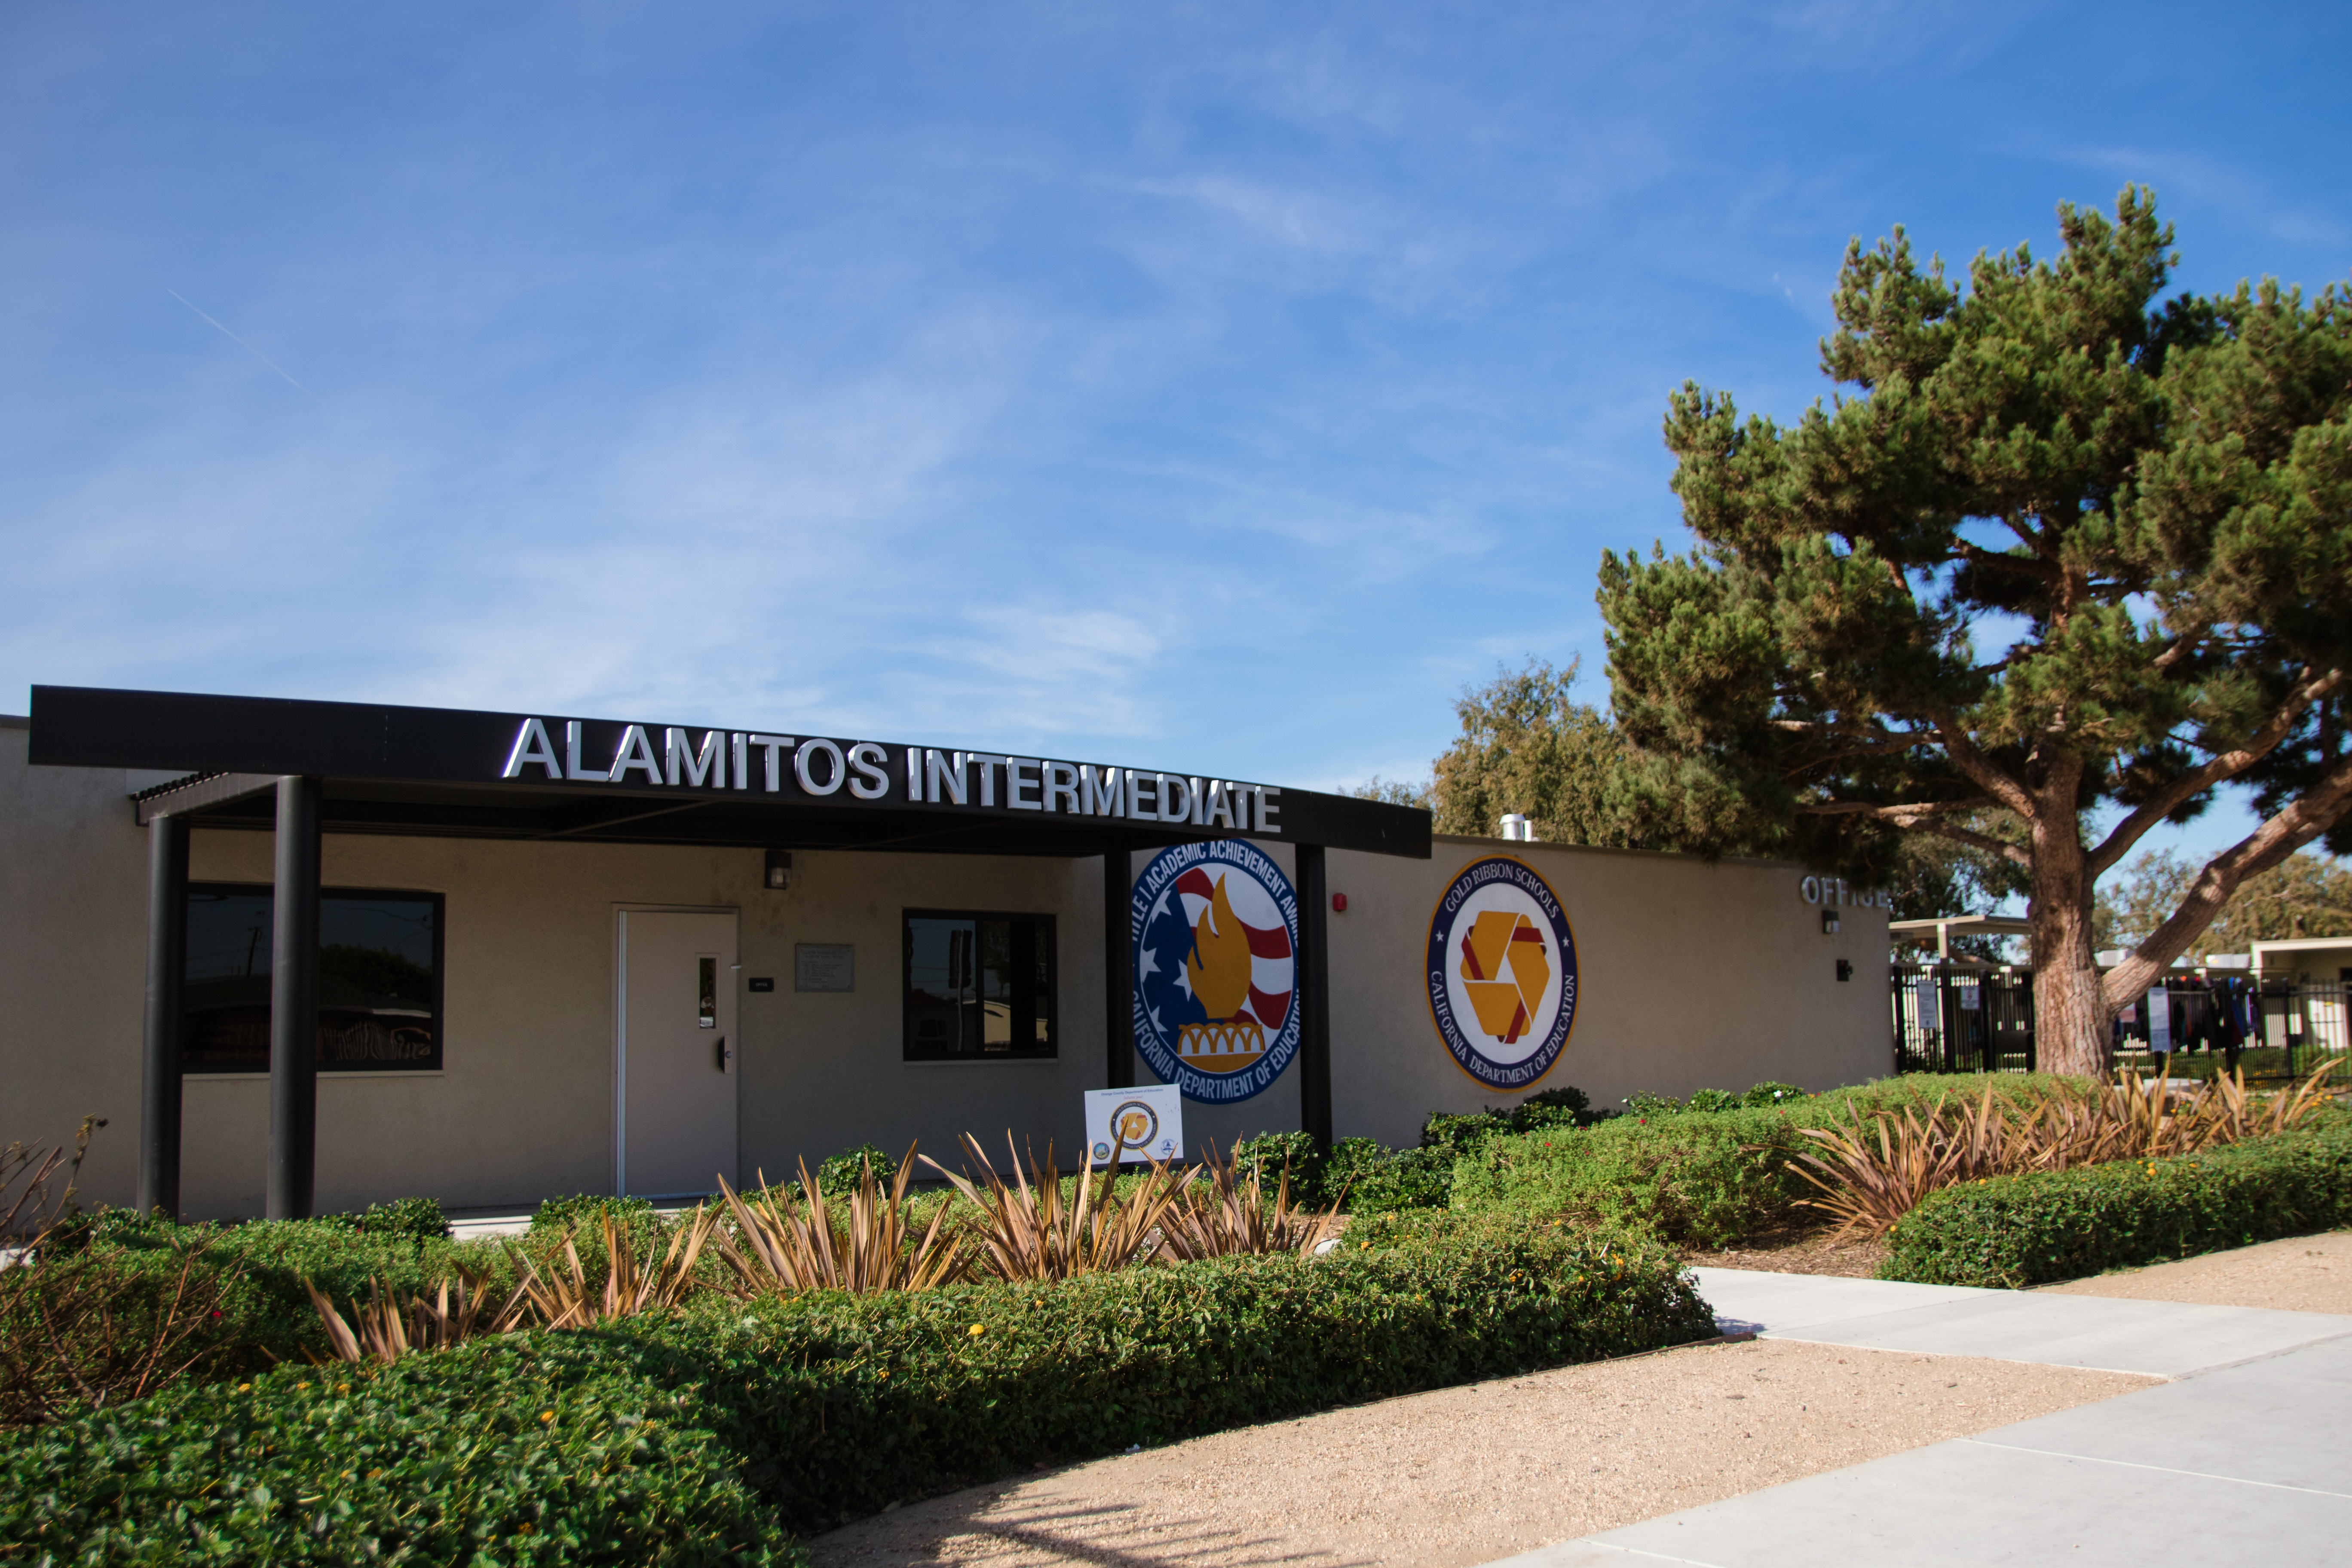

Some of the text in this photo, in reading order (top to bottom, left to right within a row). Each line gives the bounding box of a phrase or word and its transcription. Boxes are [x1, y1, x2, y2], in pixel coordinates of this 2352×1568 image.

[503, 718, 1281, 833] ALAMITOS INTERMEDIATE
[1145, 842, 1207, 894] ACADEMIC
[1209, 840, 1287, 898] ACHIEVEMENT
[1280, 895, 1298, 948] AWA
[1446, 863, 1559, 919] GOLD RIBBON SCHOOLS
[1174, 1066, 1254, 1099] DEPARTMENT
[1256, 1060, 1271, 1085] OF
[1269, 988, 1300, 1071] EDUCATI
[1431, 970, 1574, 1083] CALIFORNIA DEPARTMENT OF EDUCATION
